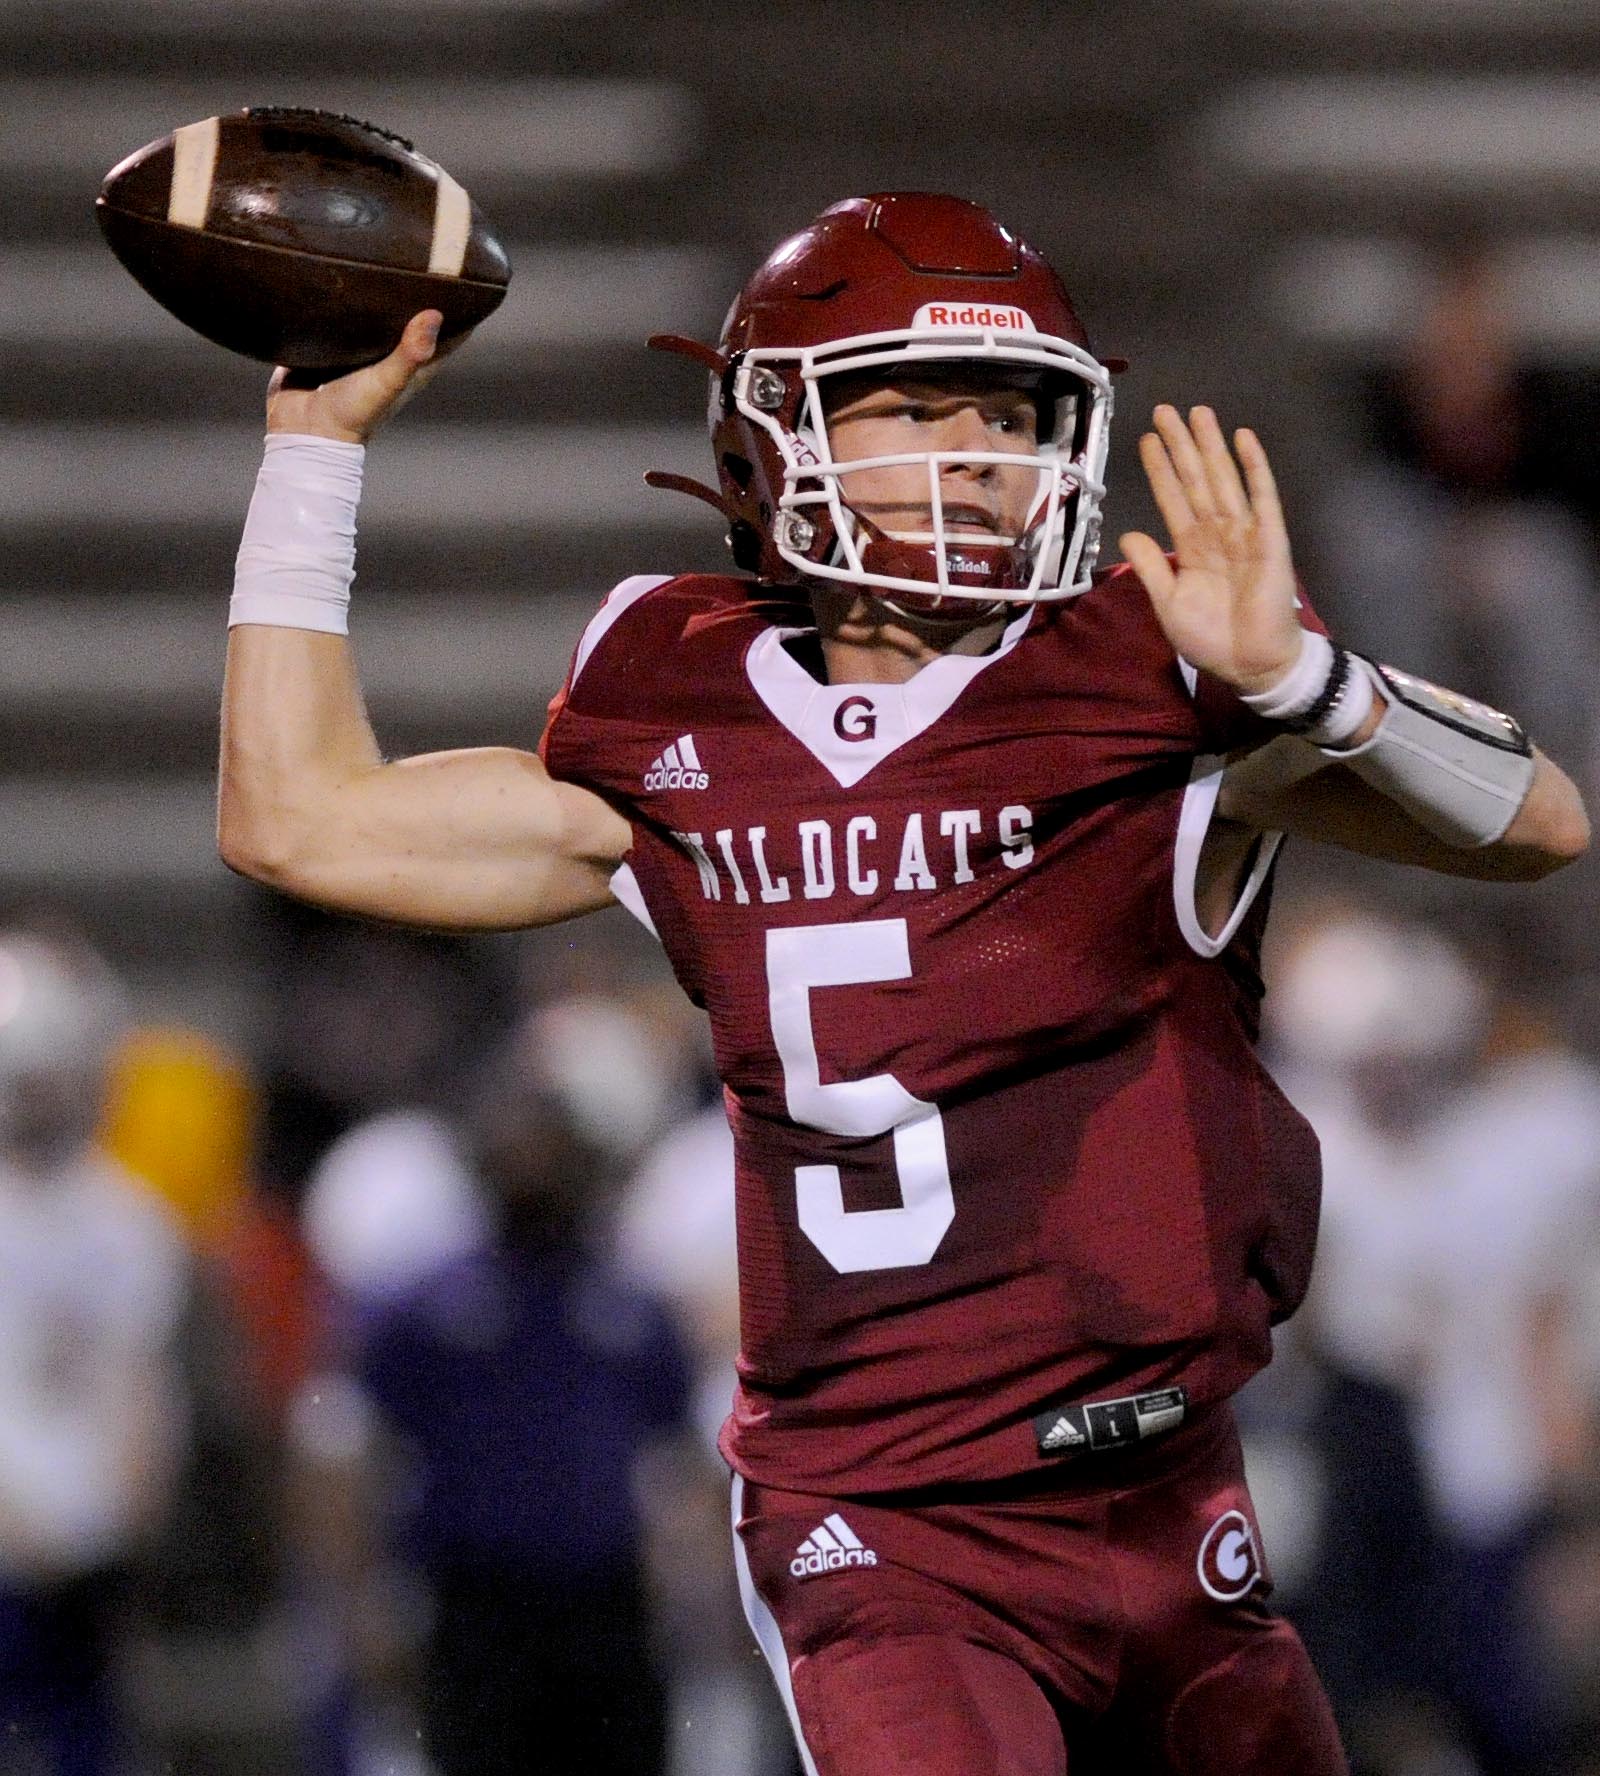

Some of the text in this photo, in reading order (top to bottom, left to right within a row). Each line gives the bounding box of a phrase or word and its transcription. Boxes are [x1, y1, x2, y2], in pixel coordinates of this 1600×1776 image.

[928, 306, 1025, 329] Riddell
[832, 695, 878, 743] G
[643, 766, 710, 791] adidas
[668, 804, 1036, 906] WILDCATS
[765, 917, 956, 1274] 5
[790, 1546, 878, 1577] adidas
